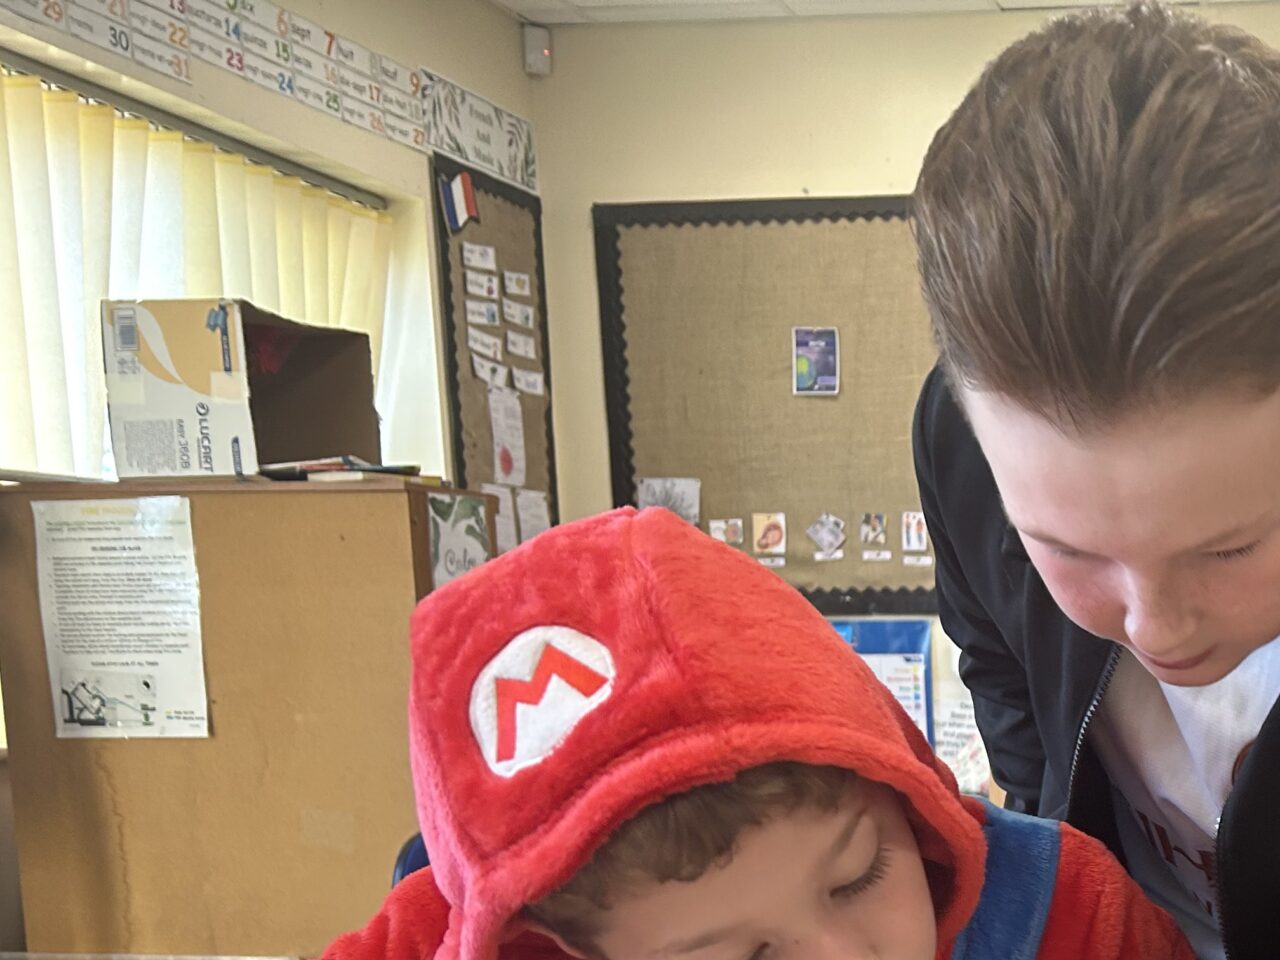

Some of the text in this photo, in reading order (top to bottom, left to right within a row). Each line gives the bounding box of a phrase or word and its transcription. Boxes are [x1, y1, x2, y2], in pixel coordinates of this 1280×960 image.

[108, 25, 130, 51] 30
[168, 21, 189, 48] 22
[324, 30, 336, 56] 7
[225, 47, 244, 71] 23
[275, 39, 290, 62] 15
[409, 71, 420, 96] 9
[199, 418, 215, 473] LUCART
[495, 641, 610, 765] M
